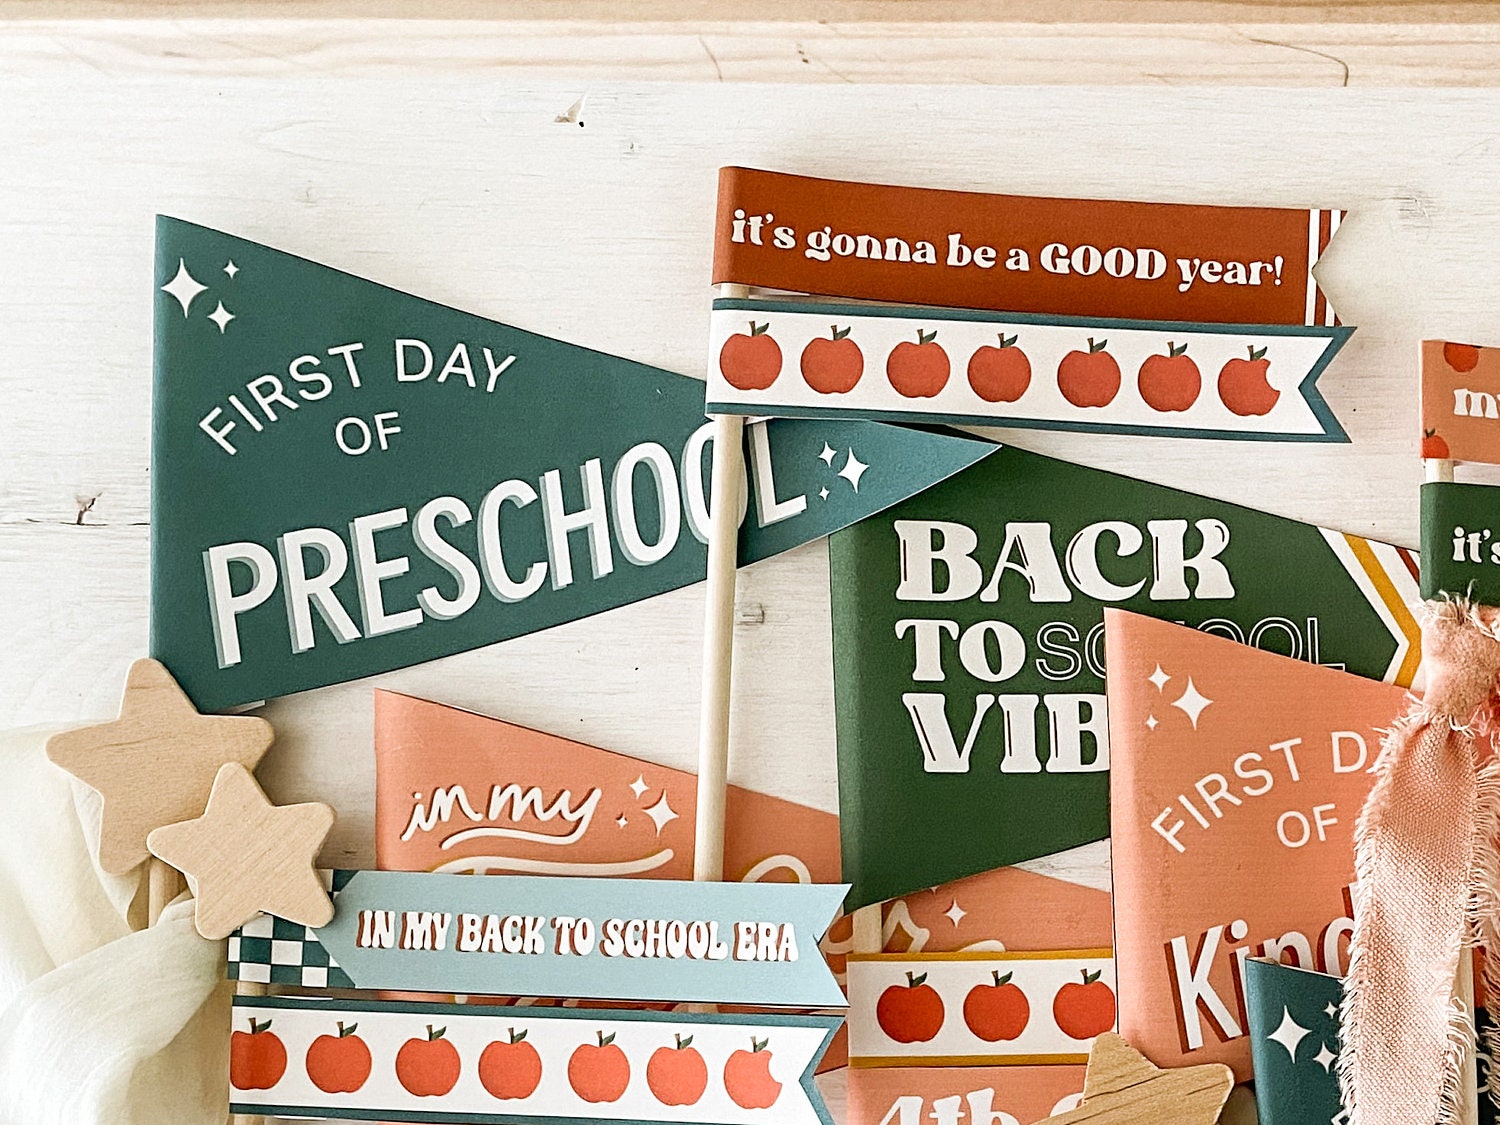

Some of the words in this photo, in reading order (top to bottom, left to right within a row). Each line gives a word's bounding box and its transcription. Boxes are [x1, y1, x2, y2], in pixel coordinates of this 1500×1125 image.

[731, 207, 795, 250] it's
[805, 226, 937, 266] gonna
[947, 233, 996, 269] be
[1006, 247, 1030, 272] a
[1040, 243, 1167, 279] GOOD
[1176, 255, 1285, 293] year!
[198, 341, 366, 455] FIRST
[395, 338, 517, 393] DAY
[335, 411, 402, 456] OF
[203, 418, 808, 669] PRESCHOOL
[894, 519, 1236, 603] BACK
[895, 618, 1026, 683] TO
[902, 693, 1111, 774] VIB
[401, 782, 482, 842] in
[460, 782, 604, 848] my
[1150, 737, 1304, 854] FIRST
[1276, 803, 1340, 849] OF
[356, 910, 397, 950] IN
[400, 911, 453, 951] MY
[457, 914, 546, 955] BACK
[551, 917, 596, 957] TO
[599, 919, 728, 961] SCHOOL
[732, 922, 800, 962] ERA
